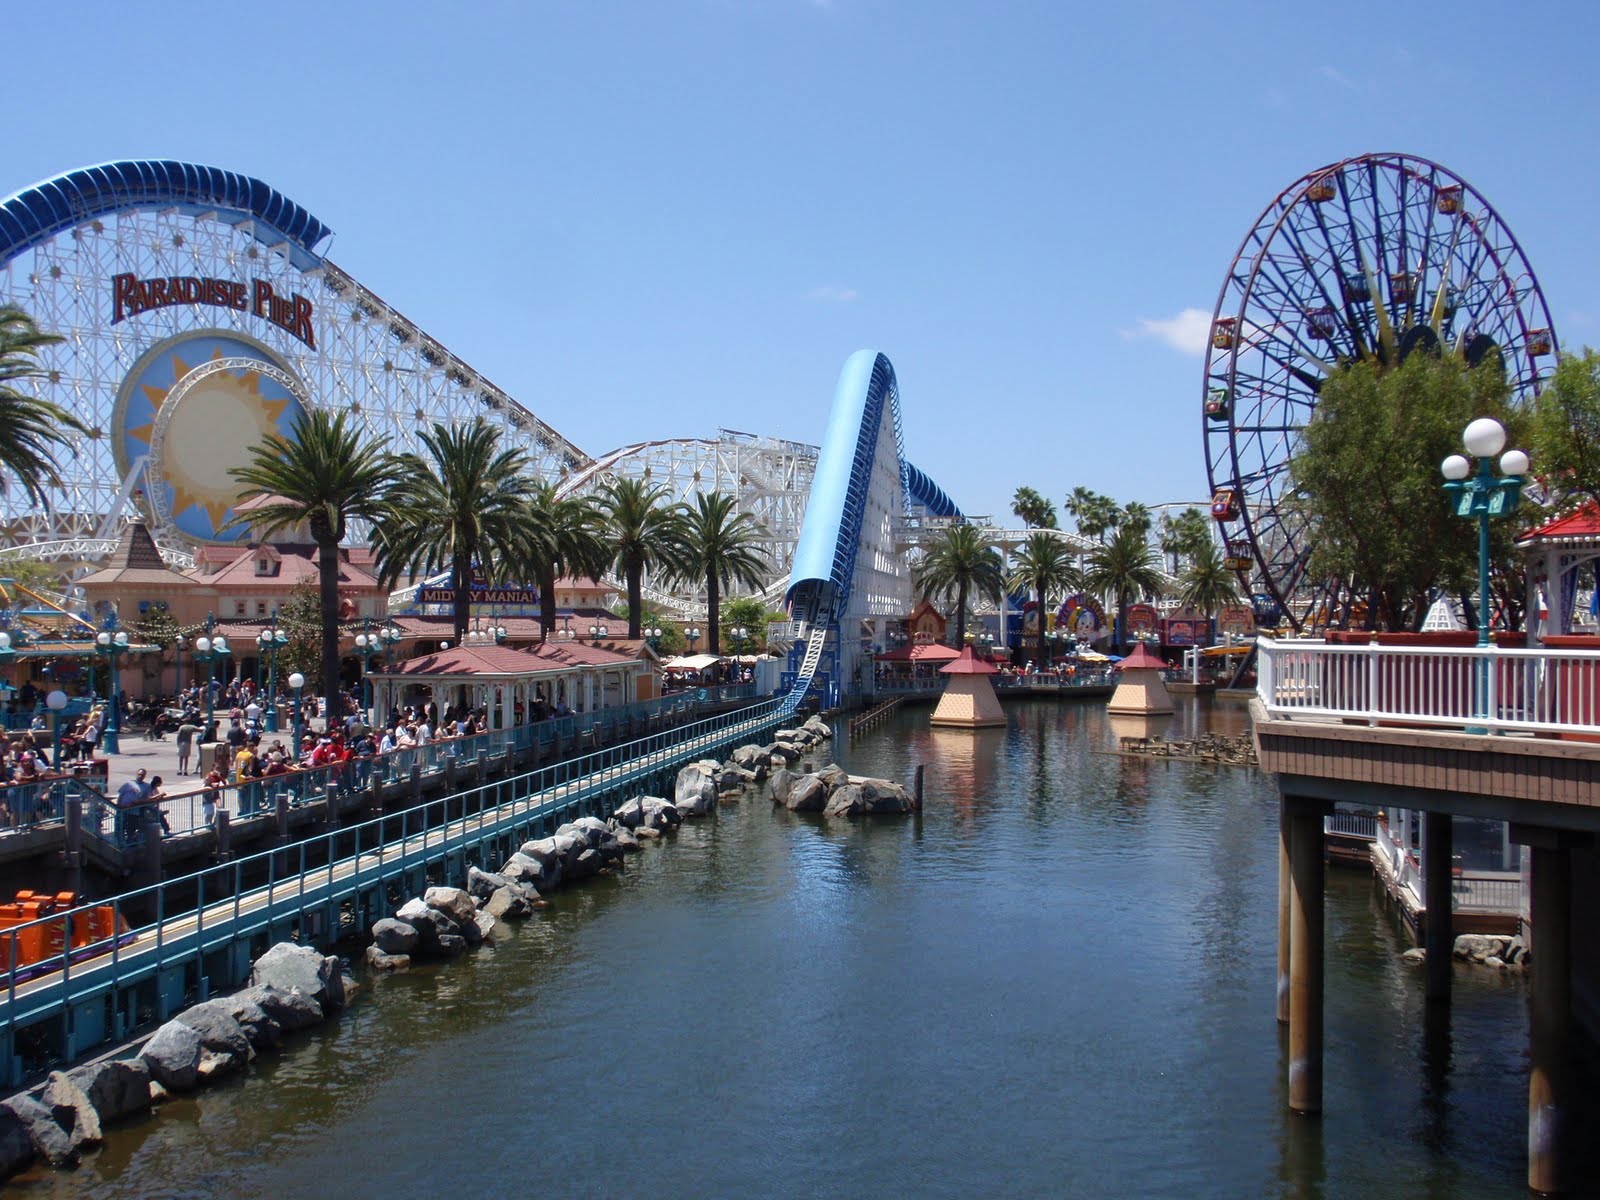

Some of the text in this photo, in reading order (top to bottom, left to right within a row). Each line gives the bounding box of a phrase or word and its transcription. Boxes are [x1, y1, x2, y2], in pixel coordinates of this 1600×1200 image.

[111, 272, 317, 351] PARADISE PIER
[423, 590, 533, 602] MIDY MANIA!
